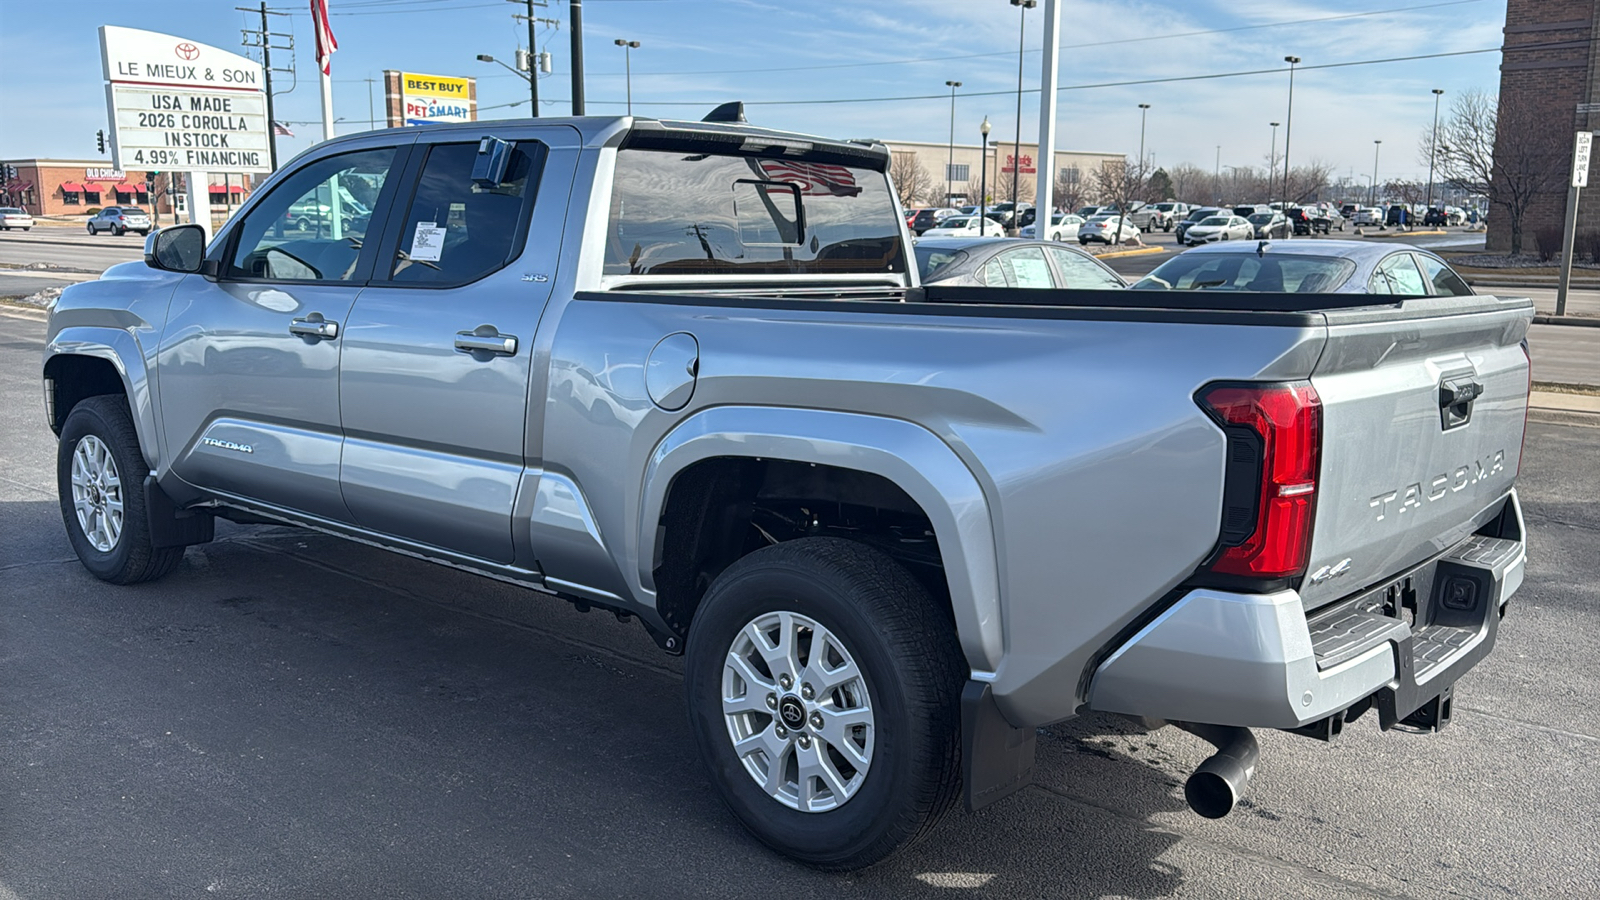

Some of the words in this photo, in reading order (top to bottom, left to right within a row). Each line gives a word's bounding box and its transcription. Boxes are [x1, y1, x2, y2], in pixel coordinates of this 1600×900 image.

[118, 62, 139, 76] LE
[147, 64, 197, 80] MIEUX
[205, 68, 215, 81] &
[223, 69, 256, 84] SON
[408, 80, 436, 91] BEST
[439, 83, 464, 93] BUY
[152, 95, 182, 111] USA
[191, 97, 232, 112] MADE
[139, 113, 175, 128] 2026
[182, 115, 247, 131] COROLLA
[135, 150, 179, 164] 4.99%
[187, 151, 259, 166] FINANCING
[1577, 154, 1587, 162] TURN
[86, 168, 99, 178] OLD
[203, 437, 254, 453] TACOMA
[1370, 449, 1505, 522] TACOMA
